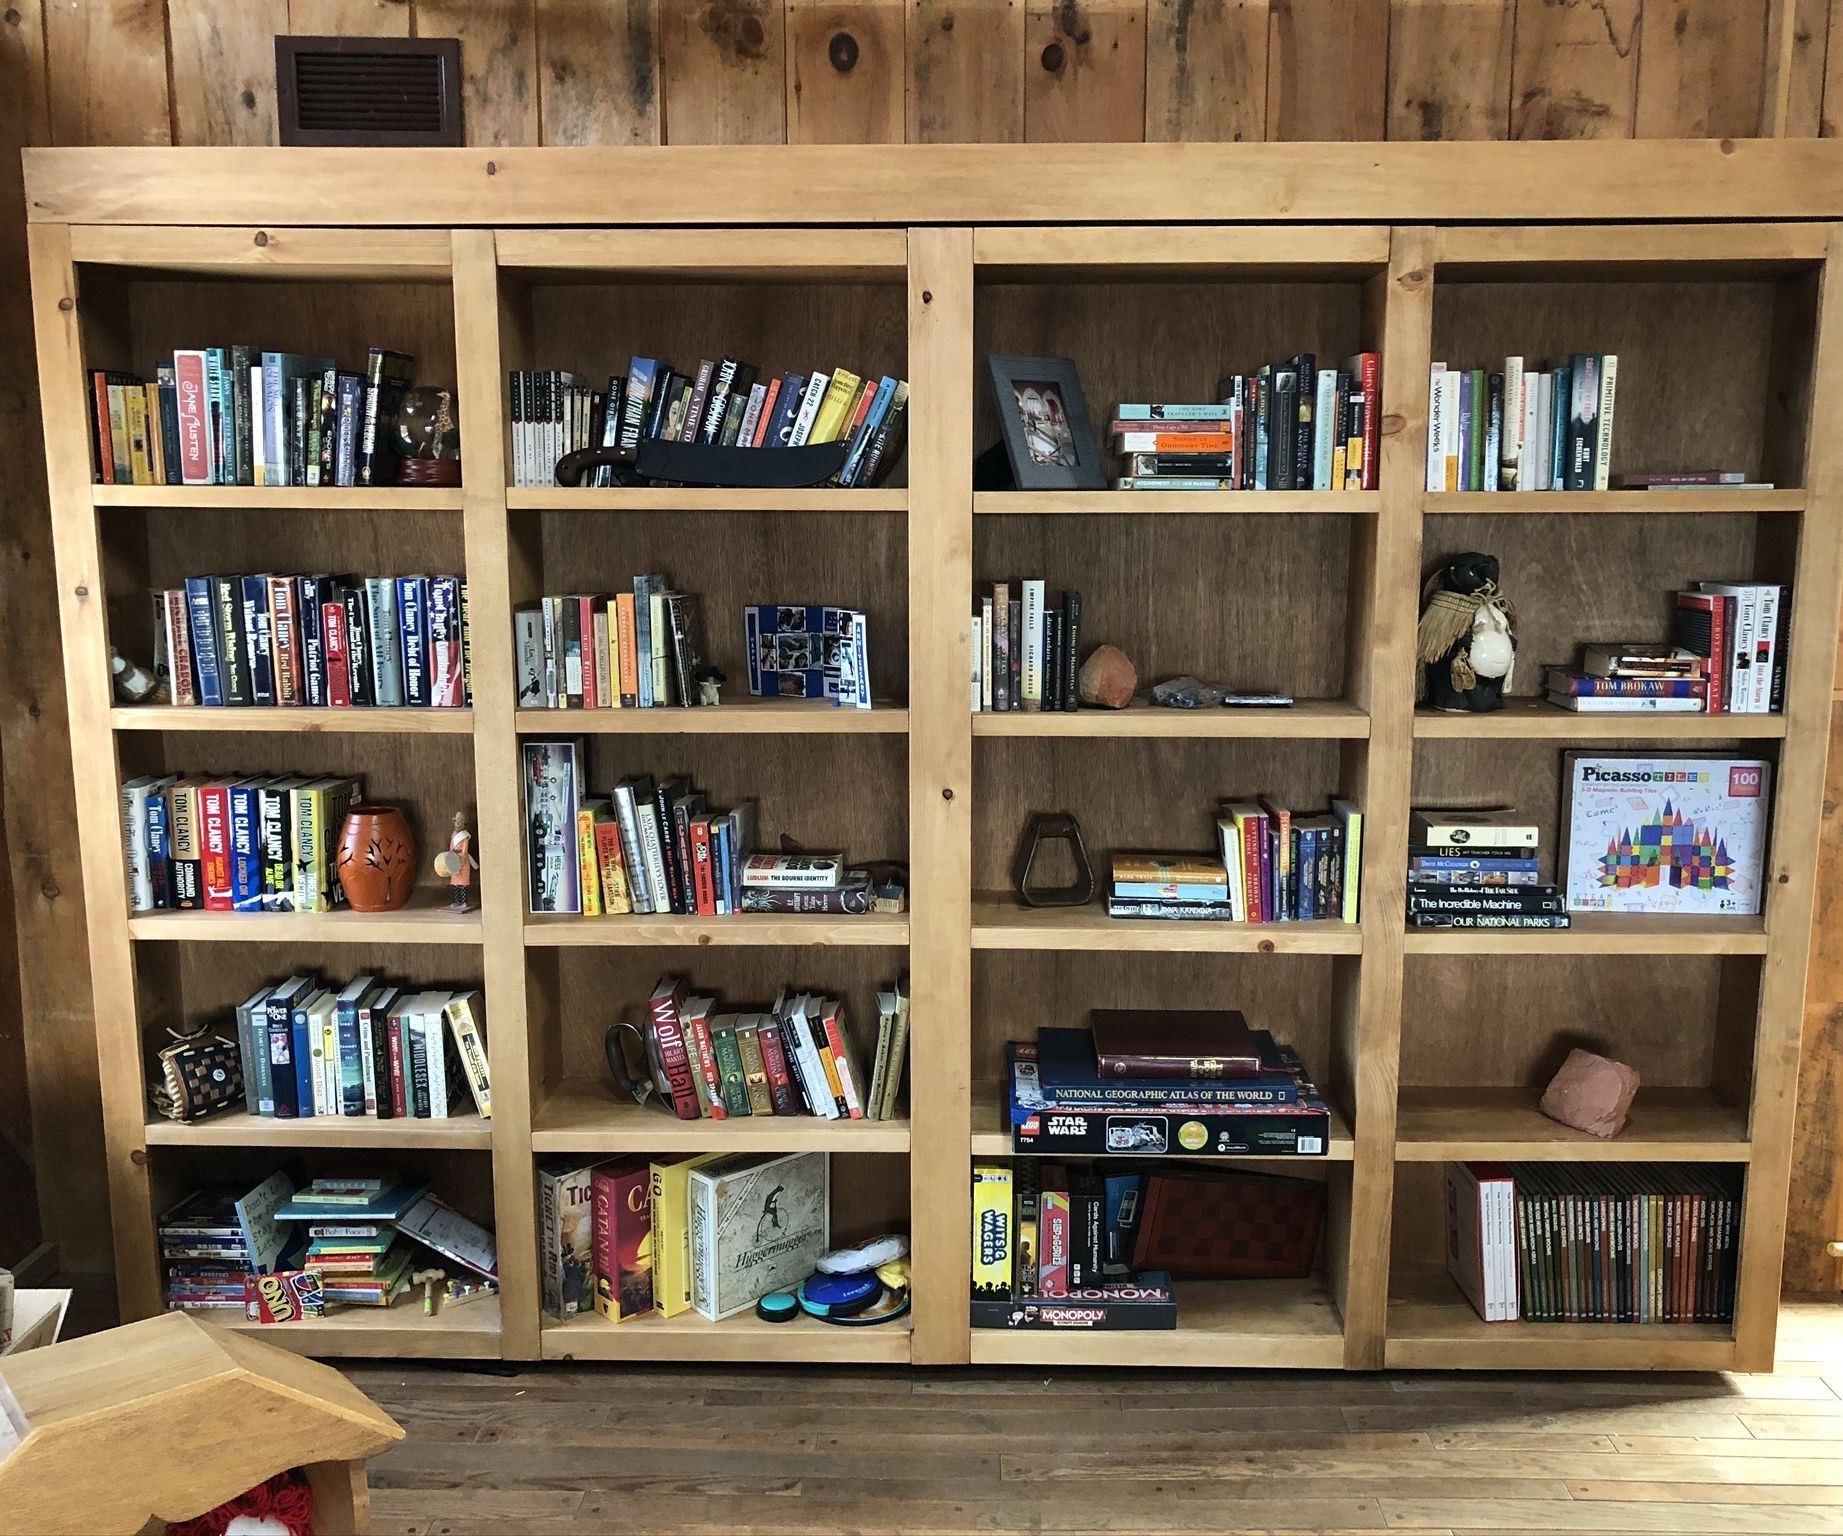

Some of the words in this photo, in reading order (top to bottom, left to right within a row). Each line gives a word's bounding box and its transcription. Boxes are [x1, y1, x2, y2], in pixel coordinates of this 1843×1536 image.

[209, 357, 219, 377] WHITE
[697, 365, 709, 391] GRISHAM
[719, 360, 737, 384] JOHN
[1366, 360, 1375, 392] Cheryl
[182, 381, 198, 413] JANE
[210, 380, 220, 401] SHARK
[806, 378, 822, 407] CATCH-22
[1604, 376, 1613, 415] PRIMITIVE
[624, 381, 646, 425] JONATHAN
[704, 396, 726, 431] GRISHAM
[1434, 386, 1442, 422] Wonder
[688, 405, 699, 428] TIME
[182, 413, 200, 460] AUSTEN
[684, 431, 693, 442] TO
[792, 423, 806, 446] JOSEPH
[1433, 422, 1441, 452] Weeks
[1600, 419, 1611, 466] TECHNOLOGY
[1574, 437, 1583, 472] EICHENWALD
[274, 585, 291, 610] Tom
[370, 583, 379, 604] The
[404, 581, 416, 600] Tom
[243, 600, 256, 632] Without
[372, 607, 380, 627] Sum
[403, 602, 417, 632] Clancy
[1743, 603, 1754, 621] Tom
[1762, 598, 1774, 614] Tom
[276, 614, 291, 649] Clancy
[327, 615, 337, 628] TOM
[1760, 616, 1772, 639] Clancy
[328, 629, 338, 652] CLANCY
[373, 631, 381, 640] of
[407, 636, 418, 657] Debt
[1713, 628, 1721, 652] BOYS
[1740, 623, 1753, 650] Clancy
[246, 633, 257, 669] Remorse
[280, 653, 291, 669] Red
[307, 639, 320, 671] Patriot
[408, 658, 419, 667] of
[376, 662, 384, 689] Fears
[409, 668, 421, 697] Honor
[1756, 678, 1764, 686] the
[1757, 665, 1766, 676] Into
[281, 672, 293, 699] Rabbit
[310, 673, 322, 704] Games
[1596, 681, 1617, 690] TOM
[1621, 681, 1664, 690] BROKAW
[1754, 687, 1764, 703] Storm
[1773, 666, 1782, 700] MARINE
[1733, 773, 1756, 784] 100
[175, 793, 188, 813] TOM
[206, 794, 220, 814] TOM
[233, 793, 248, 814] TOM
[264, 796, 280, 819] TOM
[300, 797, 313, 818] TOM
[176, 817, 190, 853] CLANCY
[207, 817, 223, 854] CLANCY
[235, 817, 250, 854] CLANCY
[267, 822, 282, 861] CLANCY
[300, 820, 314, 857] CLANCY
[554, 855, 562, 870] HESS
[1439, 848, 1461, 856] LIES
[237, 857, 247, 883] LOCKED
[265, 867, 274, 885] ALIVE
[274, 864, 283, 879] DEAD
[647, 832, 663, 878] CHATTERLEY'S
[657, 879, 666, 901] LOVER
[175, 862, 185, 899] AUTHORITY
[184, 863, 195, 897] COMMAND
[239, 885, 248, 895] ON
[275, 880, 284, 889] OR
[296, 874, 307, 904] VECTOR
[306, 872, 317, 900] THREAT
[1420, 898, 1437, 908] The
[1438, 899, 1481, 909] Incredible
[1483, 900, 1522, 910] Machine
[1454, 917, 1474, 926] OUR
[1477, 917, 1521, 927] NATIONAL
[1523, 918, 1550, 926] PARKS
[257, 1028, 266, 1046] HEART
[362, 1022, 370, 1039] Crime
[695, 1023, 706, 1040] JASON
[259, 1048, 266, 1056] OF
[653, 1000, 681, 1048] Wolf
[669, 1063, 691, 1100] Hall
[686, 1040, 699, 1058] LIFE
[699, 1041, 711, 1067] MATTHEWS
[722, 1048, 731, 1073] MARTIN
[767, 1048, 776, 1074] MARTIN
[259, 1057, 268, 1087] DARKNESS
[363, 1052, 373, 1083] Punishment
[413, 1044, 427, 1088] MIDDLESEX
[690, 1063, 703, 1073] PI
[706, 1072, 715, 1082] RED
[708, 1084, 719, 1107] SPARROW
[1056, 1090, 1102, 1099] NATIONAL
[1105, 1091, 1167, 1100] GEOGRAPHIC
[1169, 1091, 1198, 1100] ATLAS
[1201, 1092, 1213, 1100] OF
[1216, 1091, 1235, 1100] THE
[1237, 1091, 1273, 1100] WORLD
[1048, 1116, 1087, 1126] STAR
[1048, 1126, 1087, 1135] WARS
[653, 1173, 662, 1196] GO
[544, 1184, 554, 1235] TICKET
[597, 1195, 609, 1252] CATAN
[995, 1215, 1005, 1246] WITS
[984, 1211, 994, 1263] WAGERS
[736, 1231, 810, 1268] Huggermugger
[995, 1250, 1005, 1259] &
[548, 1251, 558, 1284] RIDE
[258, 1276, 295, 1323] UNO
[1043, 1311, 1103, 1320] MONOPOLY
